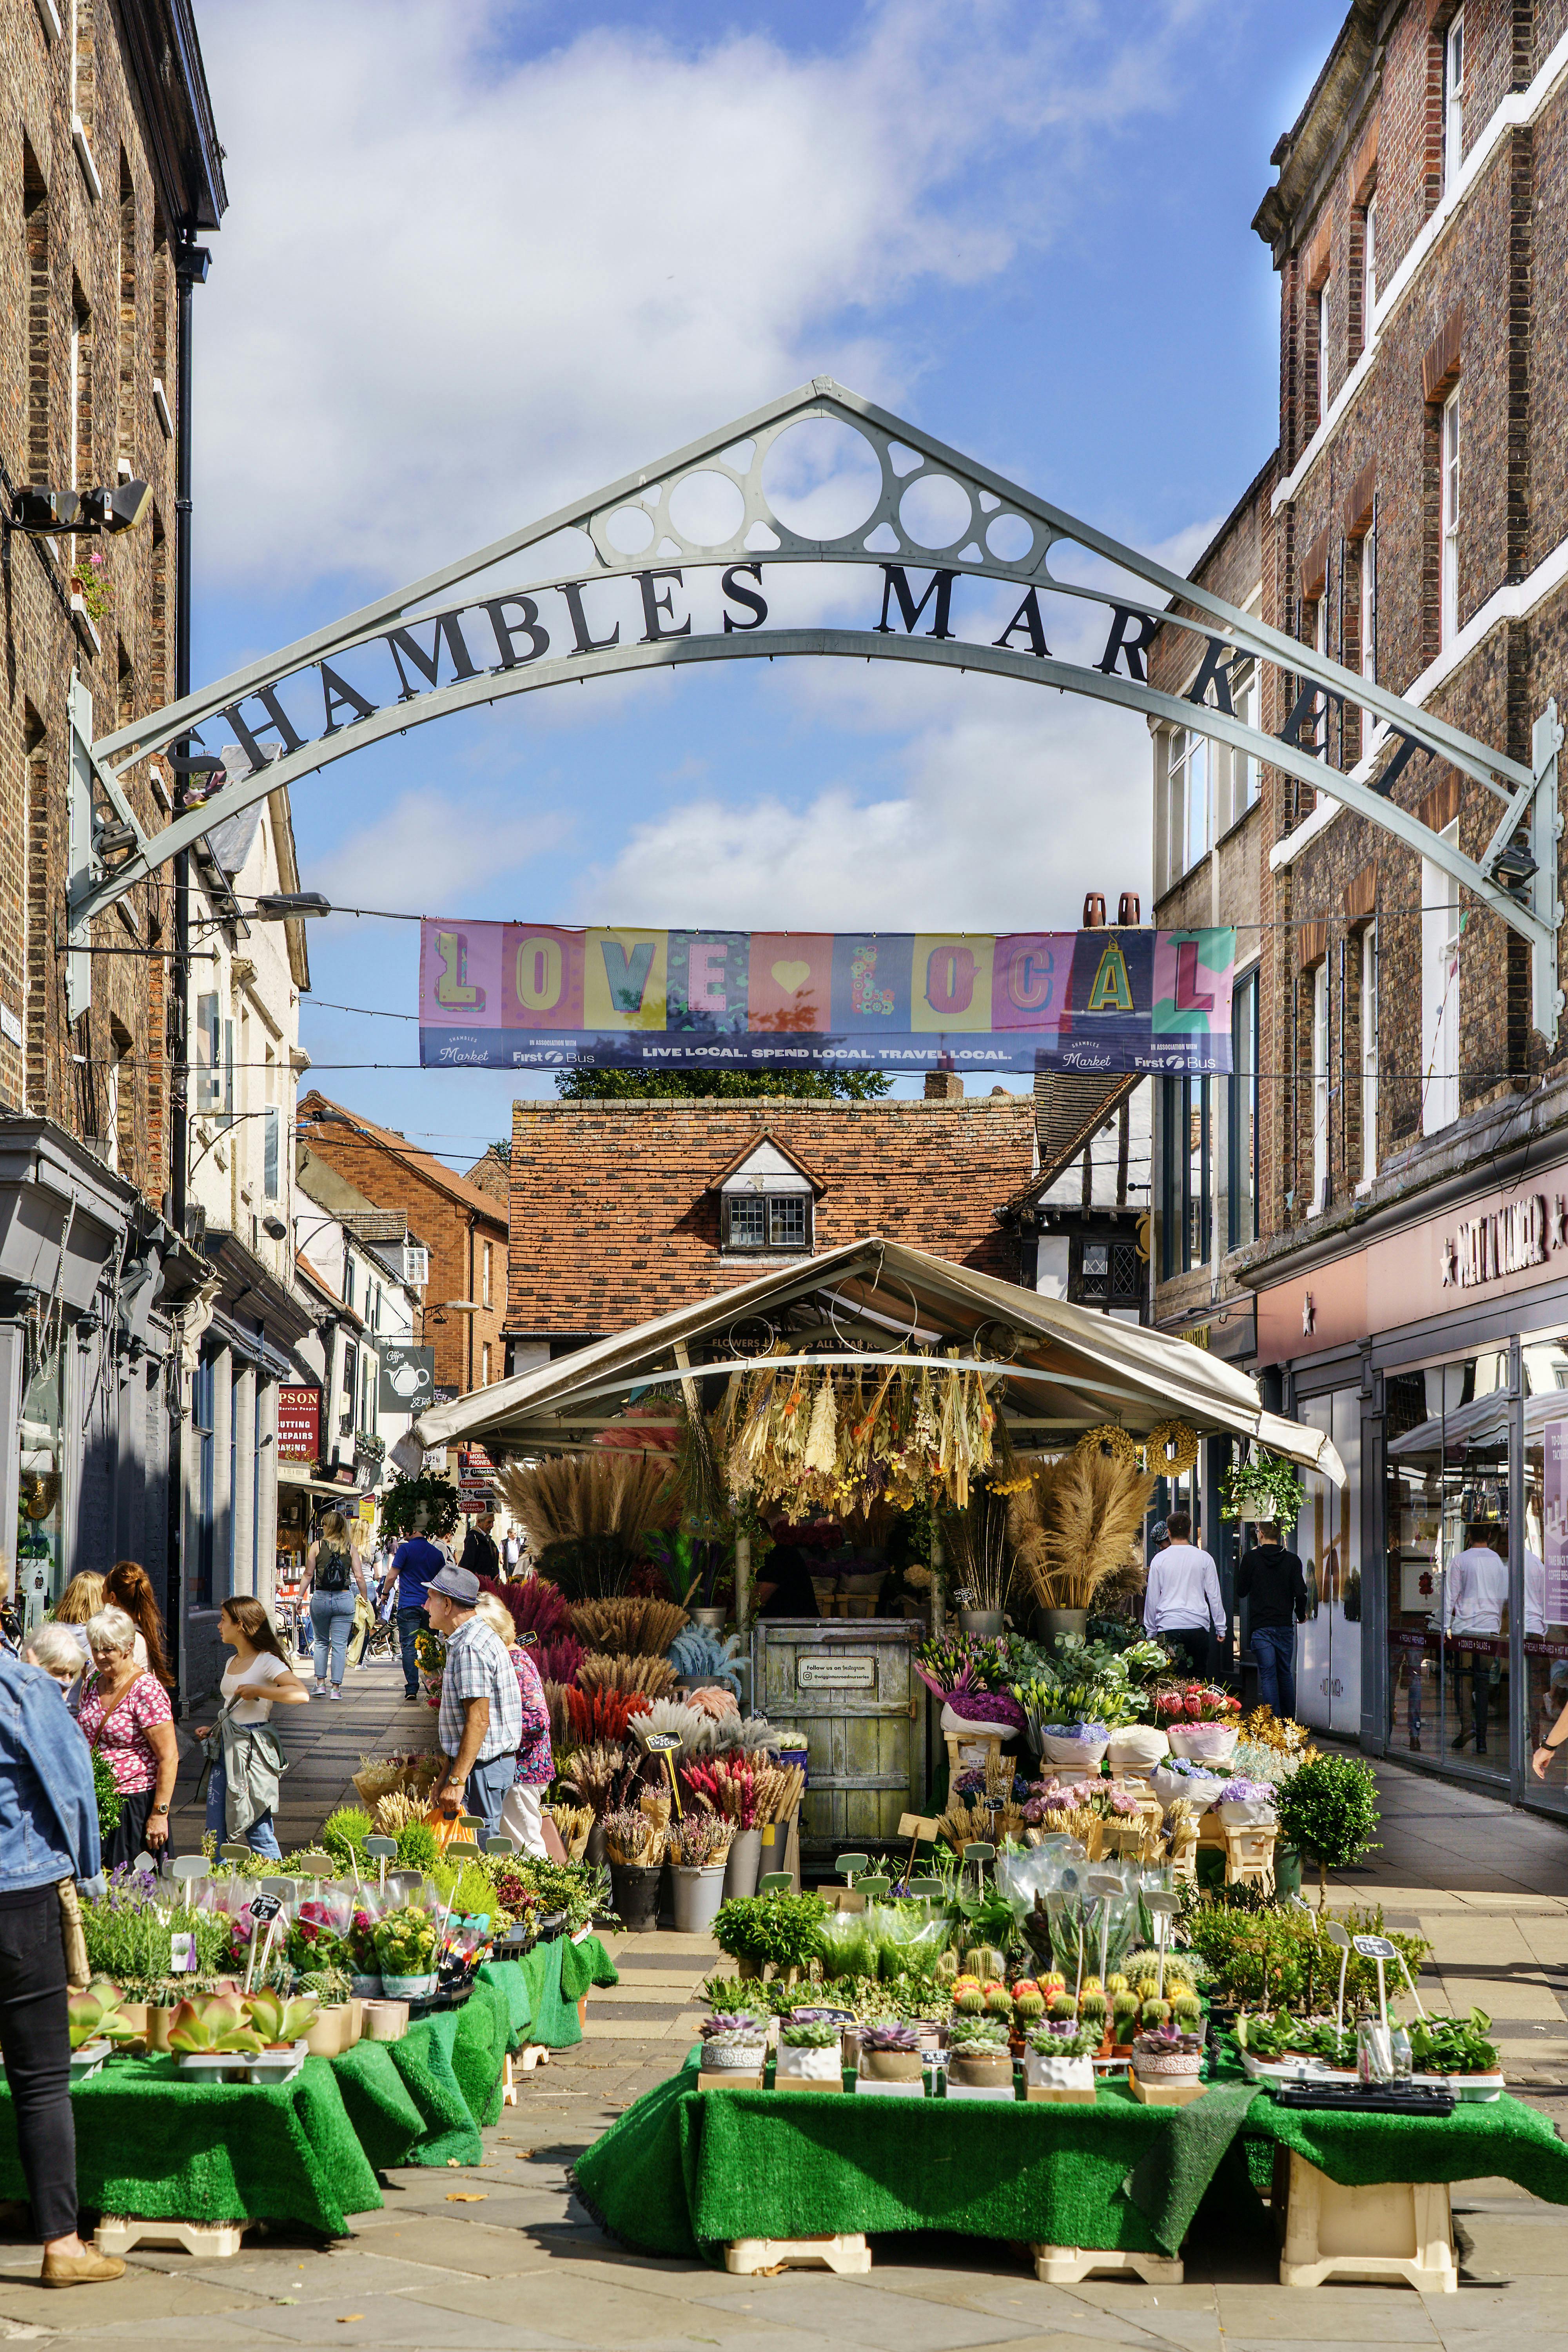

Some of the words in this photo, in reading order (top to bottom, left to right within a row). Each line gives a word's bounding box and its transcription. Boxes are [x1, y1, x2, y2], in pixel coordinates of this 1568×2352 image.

[166, 563, 769, 798] SHAMBLES
[873, 564, 1437, 800] MARKET
[434, 931, 728, 1012] LOVE
[850, 941, 1215, 1014] LOCAL
[439, 1047, 488, 1064] Market
[513, 1051, 543, 1062] First
[566, 1053, 595, 1063] Bus
[642, 1048, 682, 1056] LIVE
[685, 1047, 747, 1058] LOCAL.
[751, 1049, 809, 1058] SPEND
[813, 1049, 875, 1059] LOCAL.
[878, 1050, 947, 1059] TRAVEL
[950, 1050, 1012, 1060] LOCAL.
[1062, 1053, 1111, 1070] Market
[1134, 1057, 1164, 1068] First
[1187, 1057, 1216, 1069] Bus
[712, 1339, 760, 1348] FLOWERS
[816, 1340, 834, 1348] ALL
[387, 1351, 404, 1364] Coffee
[1461, 1640, 1473, 1648] COOKIES
[1476, 1642, 1488, 1650] SALADS
